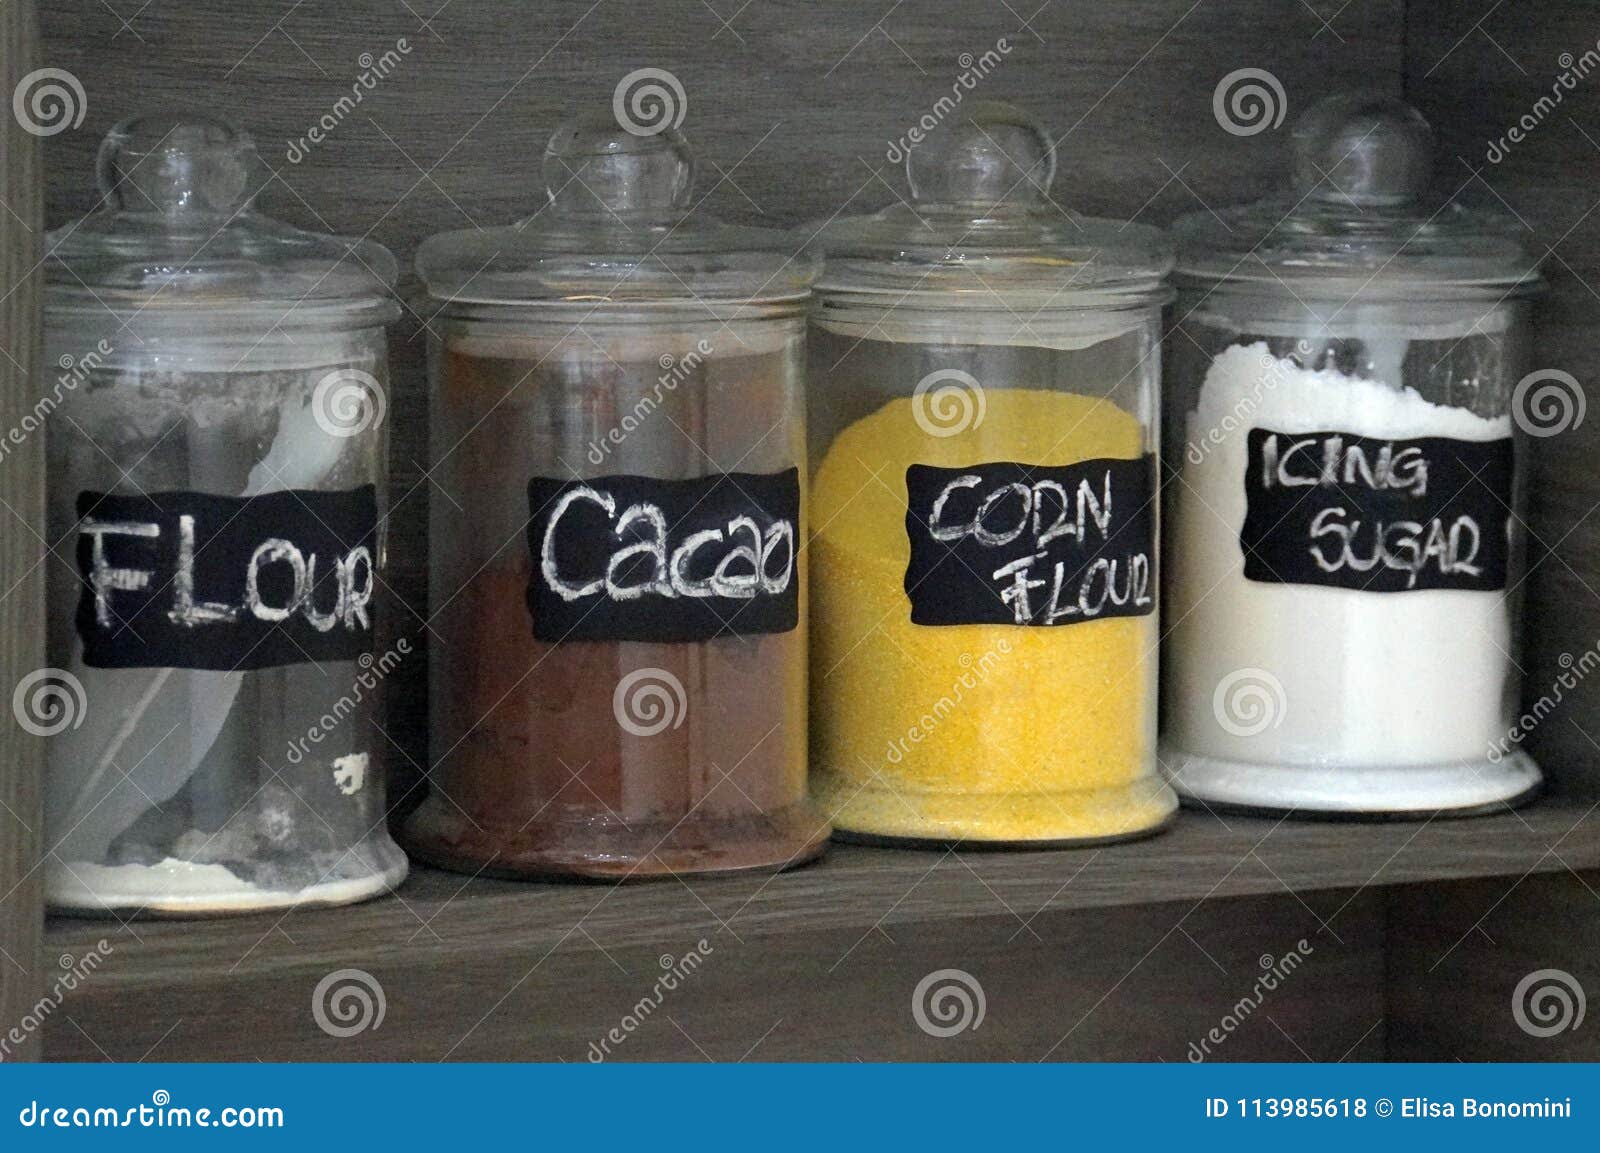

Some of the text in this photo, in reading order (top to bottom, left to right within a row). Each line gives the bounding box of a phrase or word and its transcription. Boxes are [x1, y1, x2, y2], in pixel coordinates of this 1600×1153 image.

[1263, 434, 1428, 496] ICING
[541, 486, 794, 601] Cacao
[929, 470, 1112, 550] CORN
[1310, 507, 1482, 588] SUGAR
[79, 515, 374, 632] FLOUR
[993, 551, 1150, 625] FLOUR
